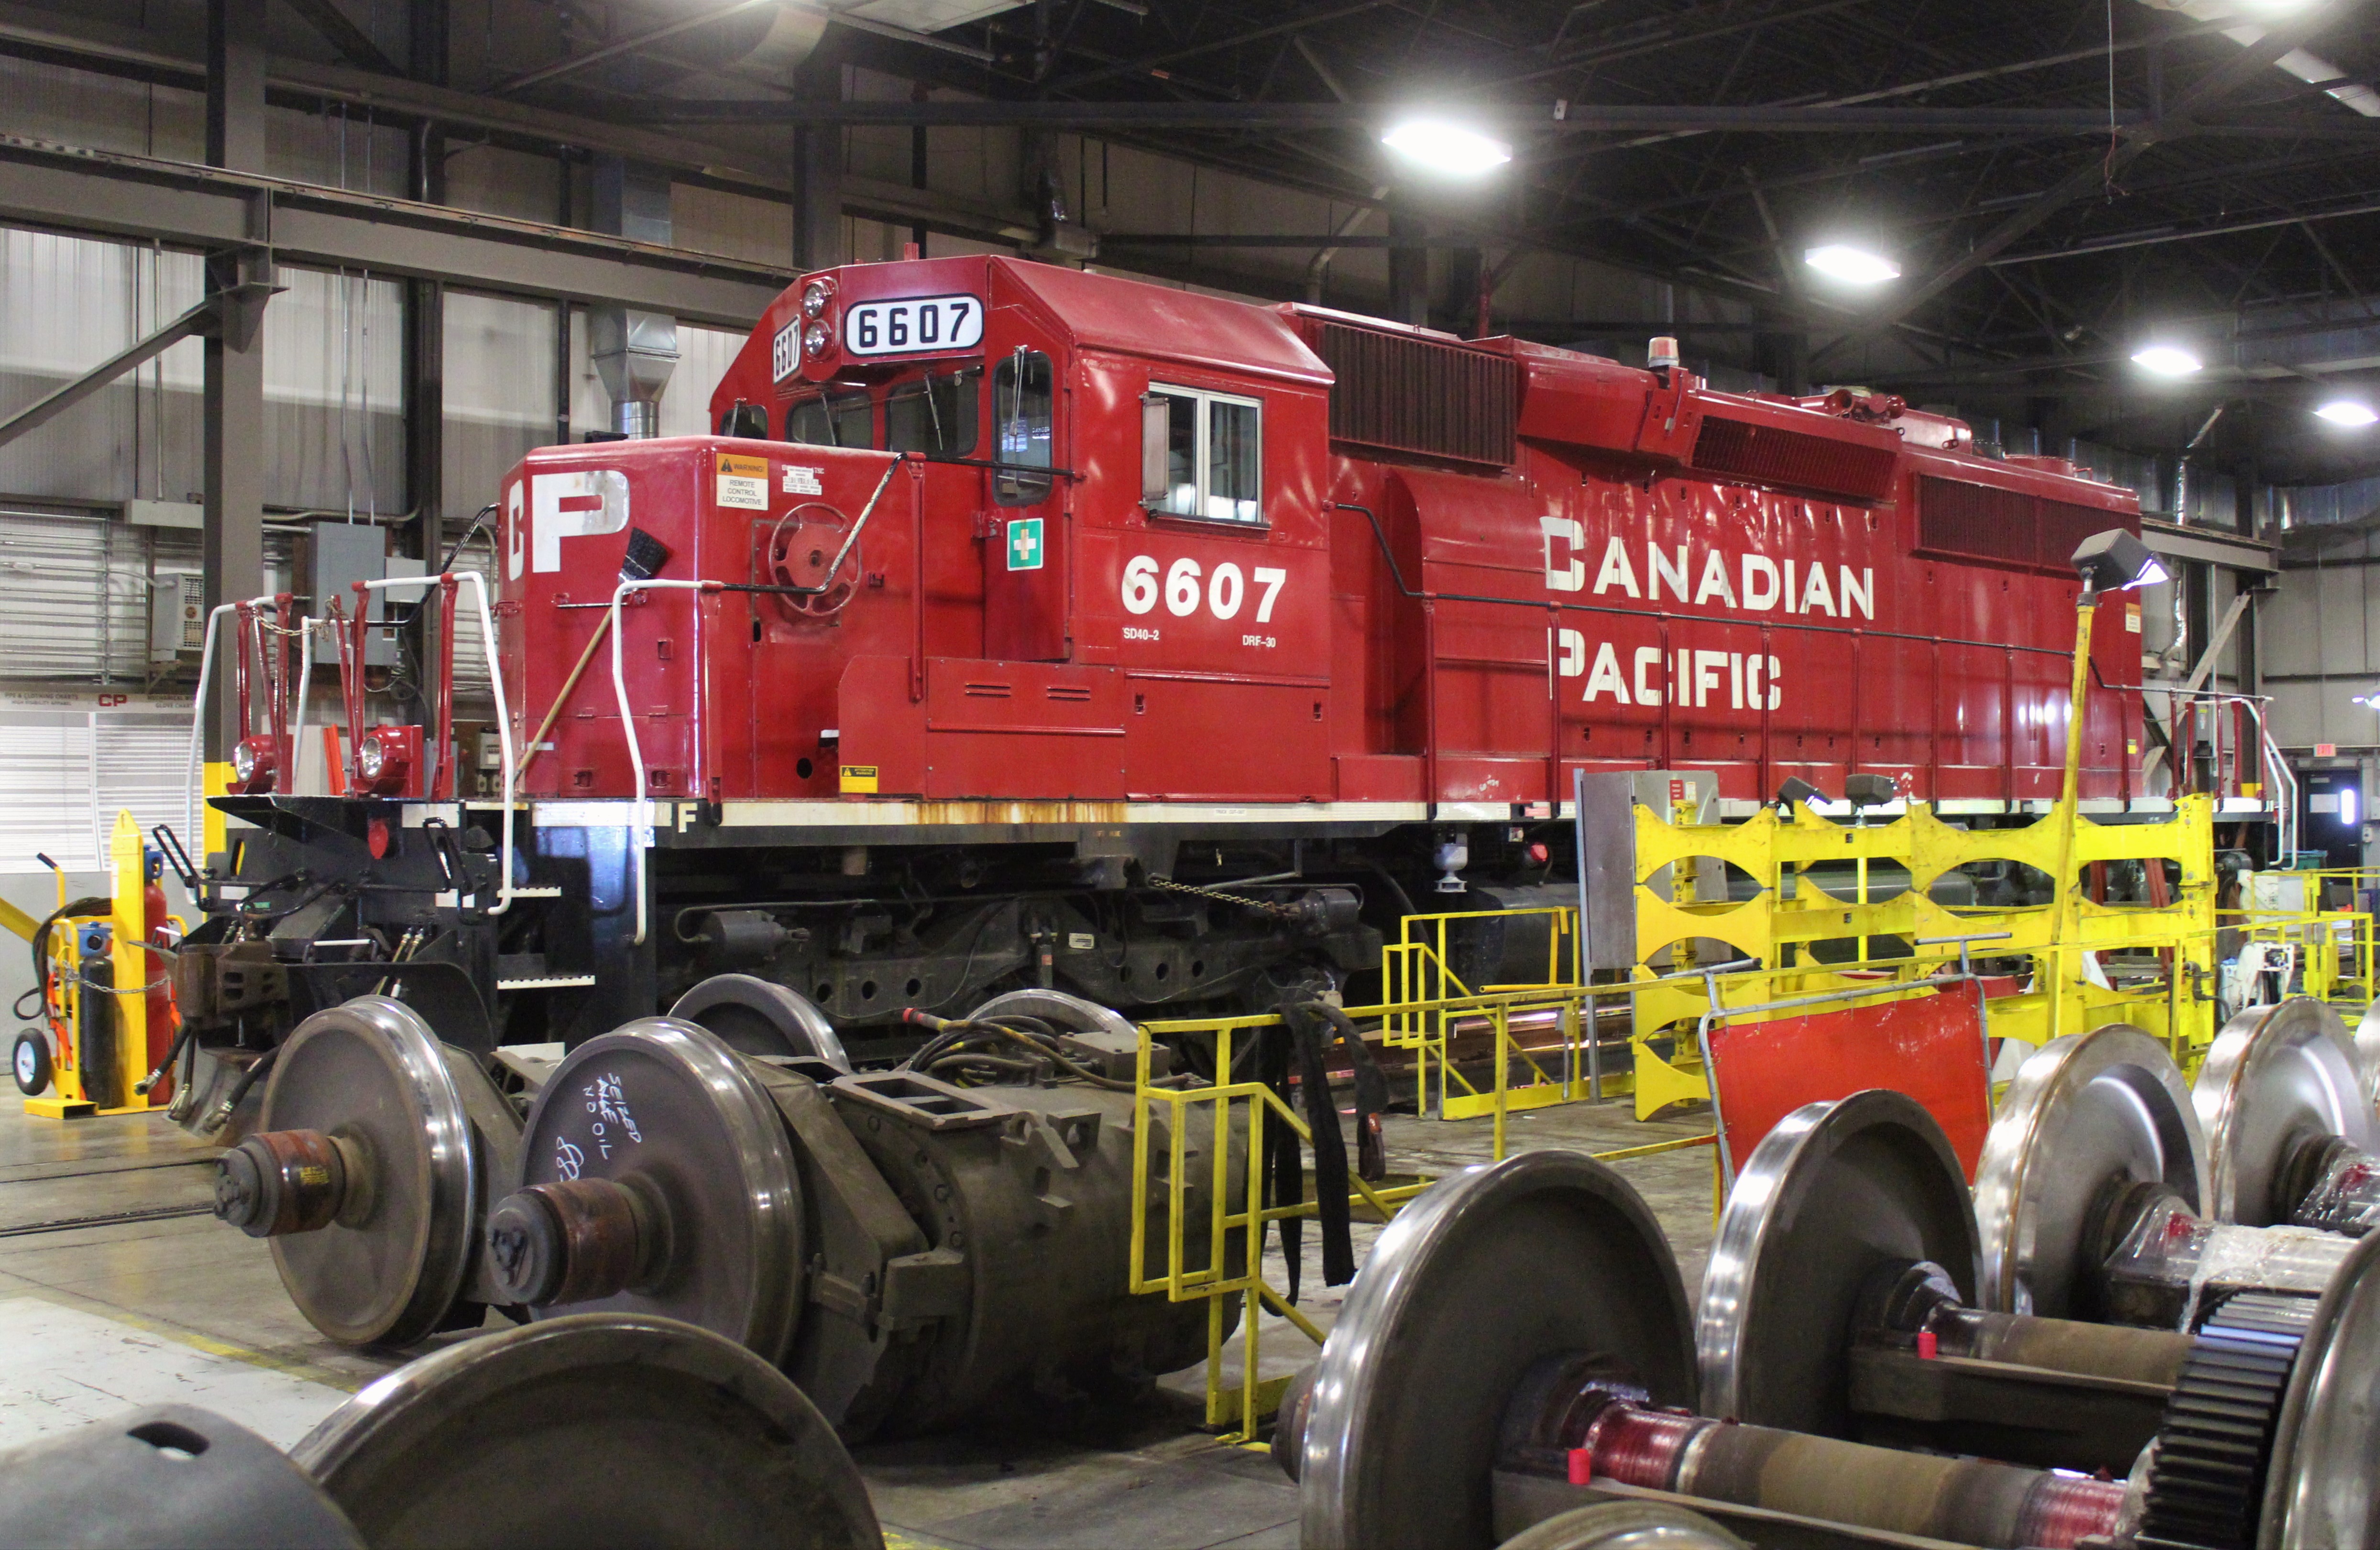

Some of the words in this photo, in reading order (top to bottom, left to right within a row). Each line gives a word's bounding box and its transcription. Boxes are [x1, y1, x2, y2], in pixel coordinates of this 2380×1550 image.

[859, 303, 969, 348] 6607
[776, 324, 798, 376] 6607
[723, 495, 762, 505] LOCOMOTIVE
[727, 488, 757, 496] CONTROL
[729, 479, 755, 488] REMOTE
[508, 470, 630, 581] CP
[1539, 516, 1874, 620] CANADIAN
[1121, 555, 1287, 623] 6607
[1123, 627, 1160, 640] SD40-2
[1242, 635, 1276, 648] DRF-30
[1547, 627, 1782, 711] PACIFIC
[98, 693, 127, 706] CP
[678, 803, 698, 833] F
[608, 1072, 642, 1143] SEIZED
[592, 1122, 613, 1160] OIL
